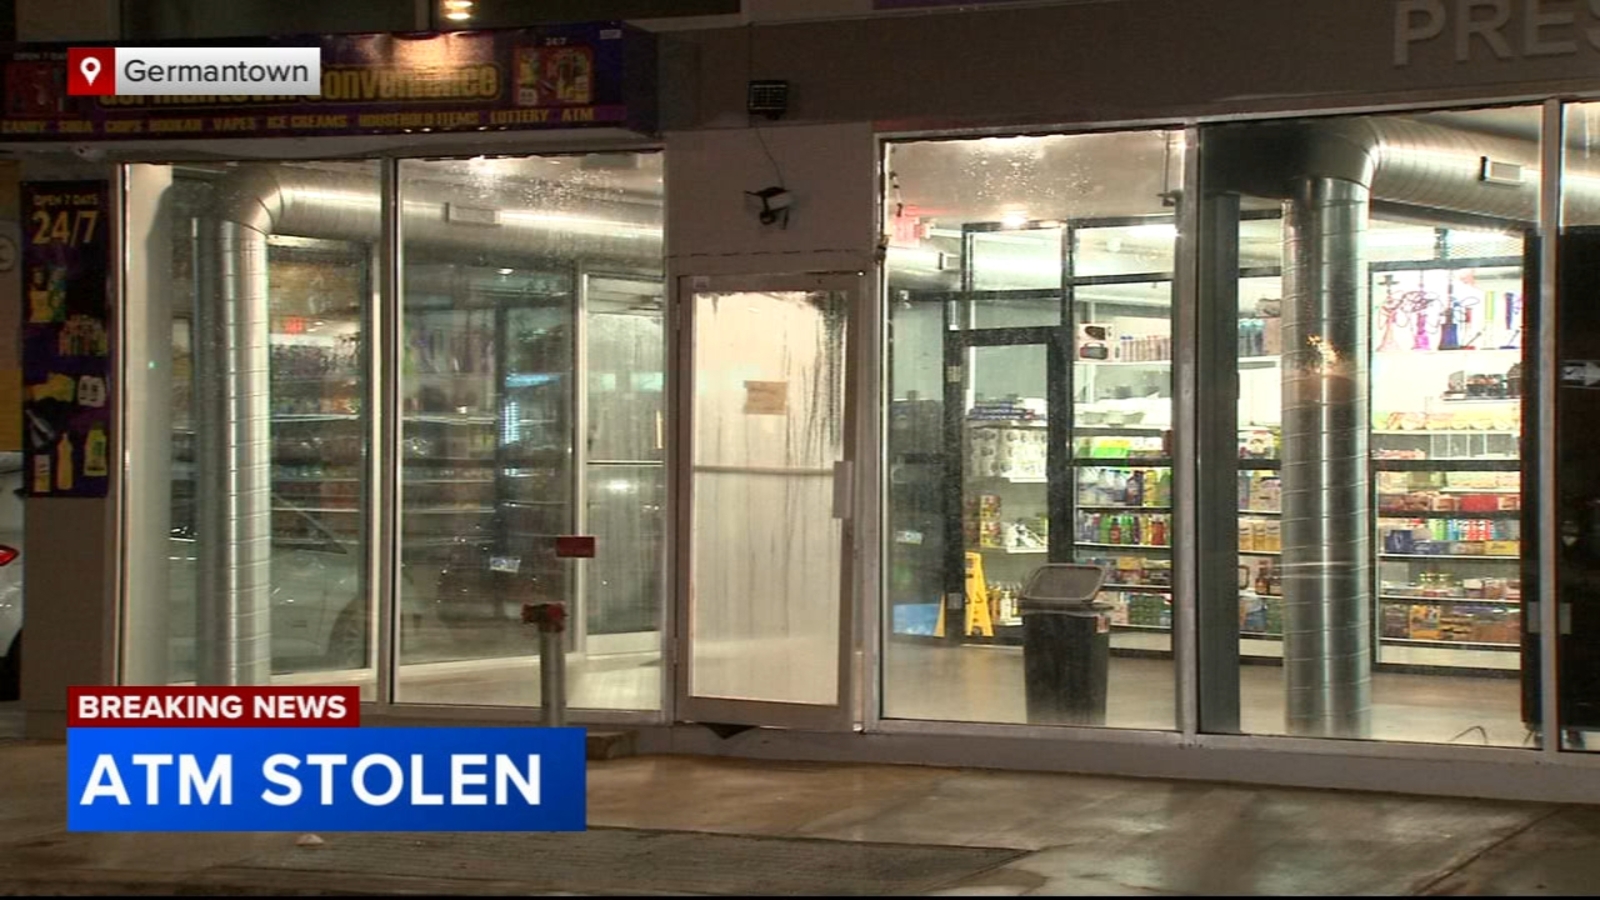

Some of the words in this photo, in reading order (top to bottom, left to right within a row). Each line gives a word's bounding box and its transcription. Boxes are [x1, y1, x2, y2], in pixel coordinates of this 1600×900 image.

[213, 116, 255, 131] VAPES
[267, 115, 290, 129] ICE
[291, 113, 348, 129] CREAMS
[359, 111, 434, 128] HOUSEHOLD
[435, 110, 480, 126] ITEMS
[490, 108, 549, 124] LOTTERY
[561, 106, 594, 122] ATM
[33, 194, 62, 206] OPEN
[63, 194, 71, 206] 7
[72, 193, 99, 206] DAYS
[31, 209, 99, 248] 24/7
